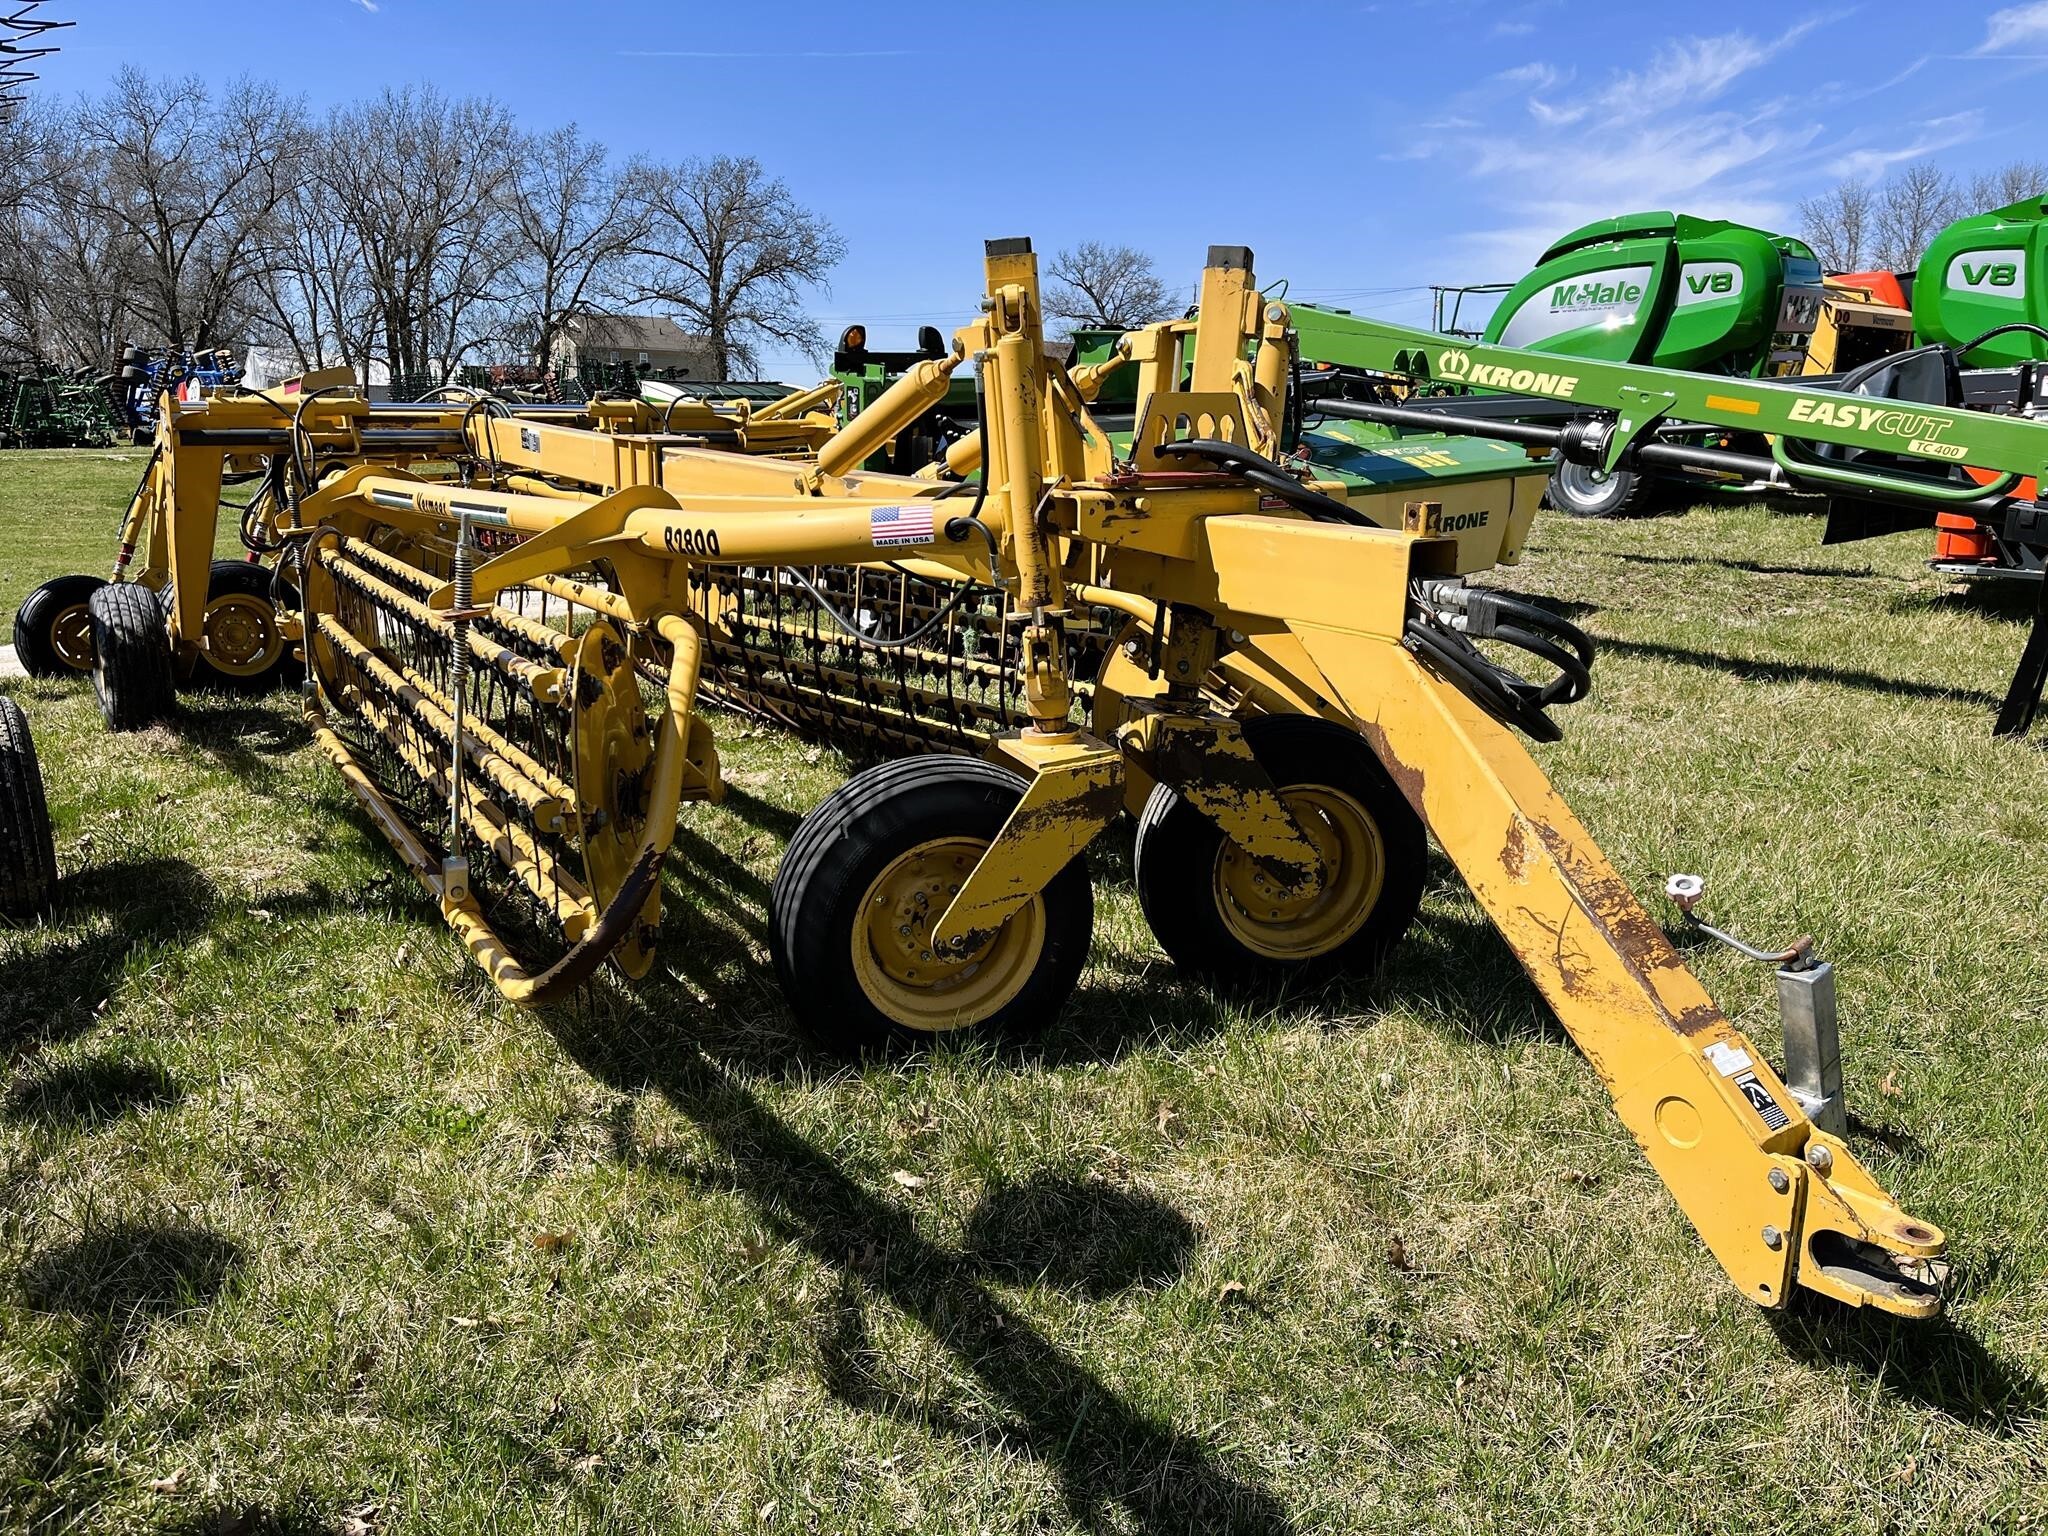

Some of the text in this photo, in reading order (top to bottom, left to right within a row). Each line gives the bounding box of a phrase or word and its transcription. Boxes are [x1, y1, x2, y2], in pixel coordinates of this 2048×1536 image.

[1686, 272, 1733, 294] V8
[1961, 263, 2017, 286] V8
[1550, 281, 1641, 307] McHale
[1468, 363, 1579, 397] KRONE
[1787, 398, 1954, 441] EASYCUT
[1915, 442, 1959, 457] TC 400
[1439, 510, 1490, 533] RONE
[664, 525, 721, 557] R2800
